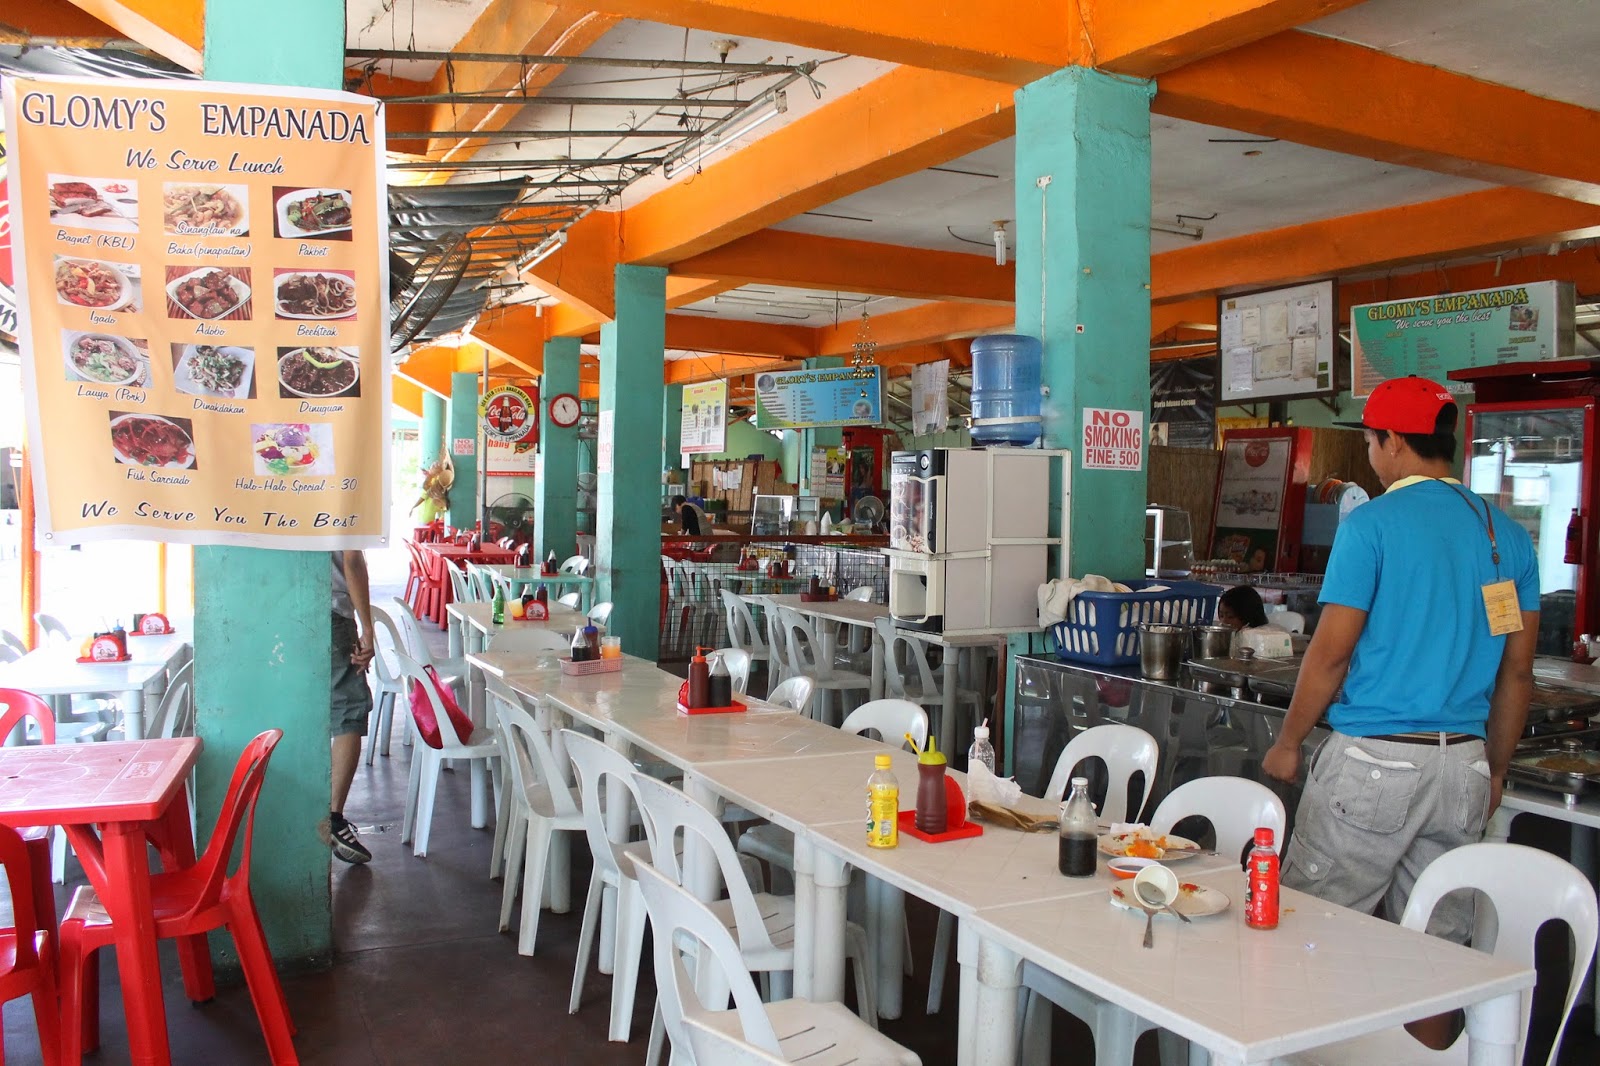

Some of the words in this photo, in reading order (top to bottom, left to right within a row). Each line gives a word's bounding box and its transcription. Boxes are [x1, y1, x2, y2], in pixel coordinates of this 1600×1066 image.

[22, 93, 166, 133] GLOMY'S
[201, 104, 370, 144] EMPANADA
[126, 148, 157, 171] We
[165, 150, 219, 172] Serve
[228, 153, 285, 175] Lunch
[56, 229, 91, 245] Bagnet
[96, 235, 136, 251] (KBL)
[298, 243, 329, 257] Pakbet
[1367, 300, 1430, 321] GLOMY'S
[1434, 287, 1529, 314] EMPANADA
[90, 311, 116, 324] Igado
[1413, 320, 1434, 328] serve
[1436, 318, 1453, 328] you
[1455, 312, 1468, 323] the
[1472, 308, 1491, 321] best
[195, 323, 225, 336] Adobo
[818, 370, 876, 382] EMPAN
[78, 385, 109, 400] Lauya
[115, 388, 146, 403] (Pork)
[193, 399, 245, 414] Dinakdakan
[299, 401, 344, 416] Dinuguan
[1093, 411, 1130, 427] NO
[1085, 425, 1141, 449] SMOKING
[1086, 449, 1116, 464] FINE:
[1119, 451, 1140, 465] 500
[127, 468, 145, 481] Fish
[150, 471, 190, 485] Sarciado
[235, 479, 287, 492] Halo-Halo
[290, 479, 326, 494] Special
[340, 478, 357, 490] 30
[81, 500, 119, 519] We
[134, 501, 197, 522] Serve
[213, 507, 248, 526] You
[262, 511, 298, 528] The
[313, 512, 358, 529] Best
